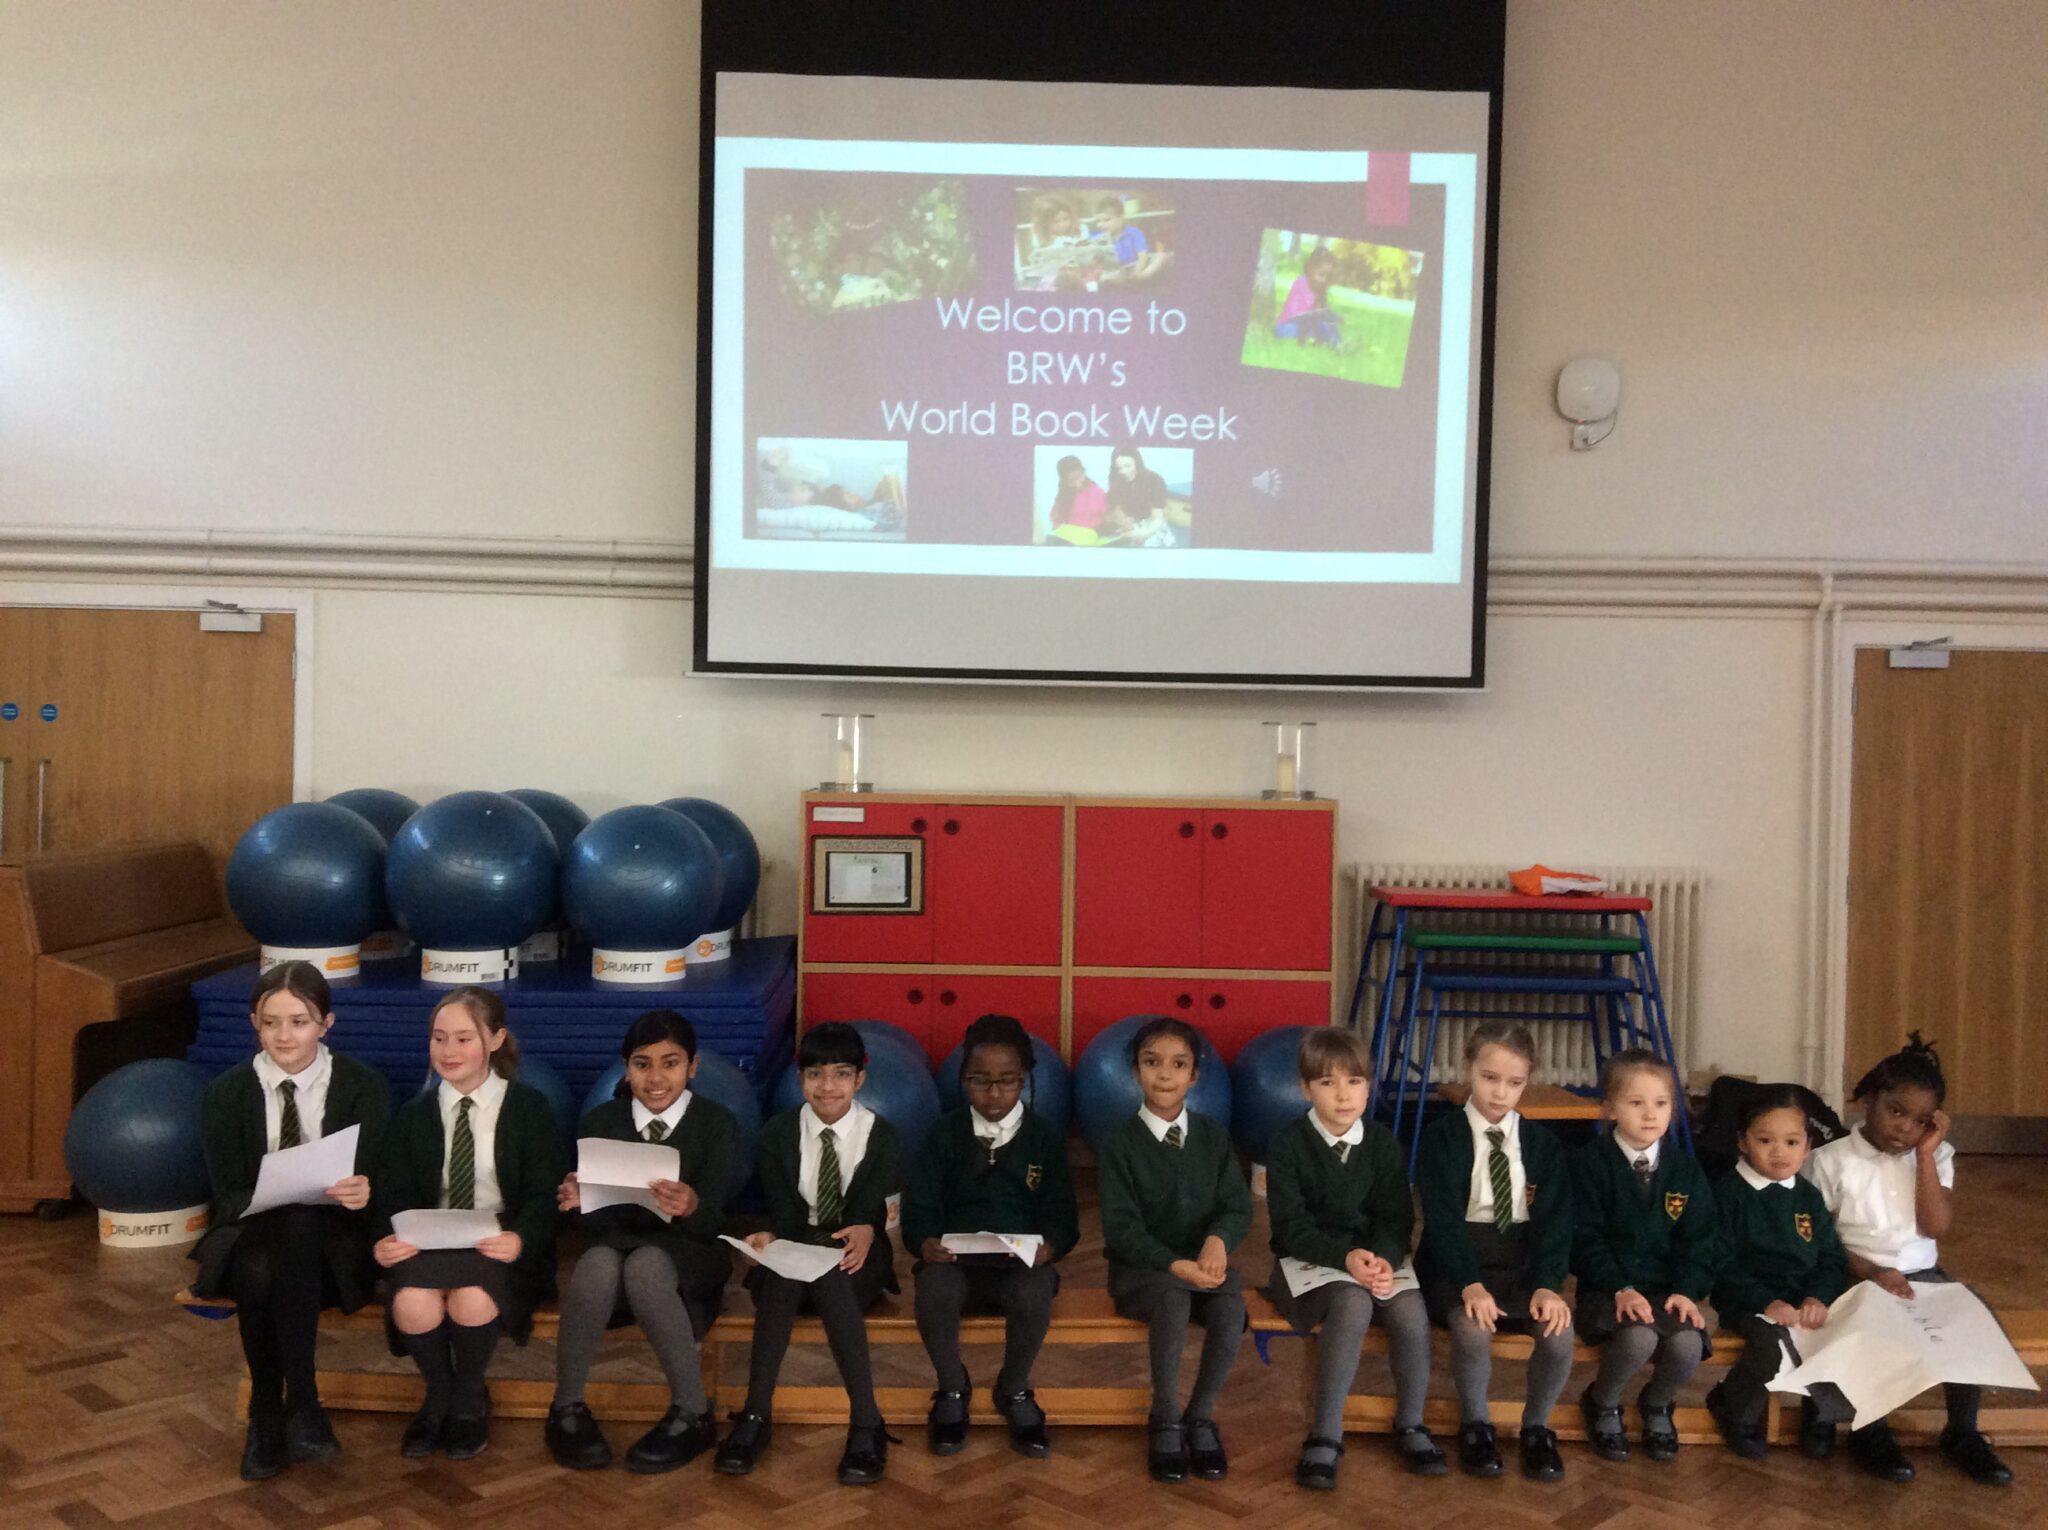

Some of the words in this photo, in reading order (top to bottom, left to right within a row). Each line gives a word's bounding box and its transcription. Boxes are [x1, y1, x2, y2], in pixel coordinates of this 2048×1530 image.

[936, 297, 1132, 334] Welcome
[1147, 300, 1187, 335] to
[1007, 351, 1127, 387] BRW's
[881, 400, 997, 436] World
[1011, 403, 1110, 438] Book
[1124, 405, 1239, 441] Week
[428, 961, 480, 973] DRUMFIT
[602, 962, 653, 973] DRUMFIT
[111, 1223, 172, 1236] DRUMFIT
